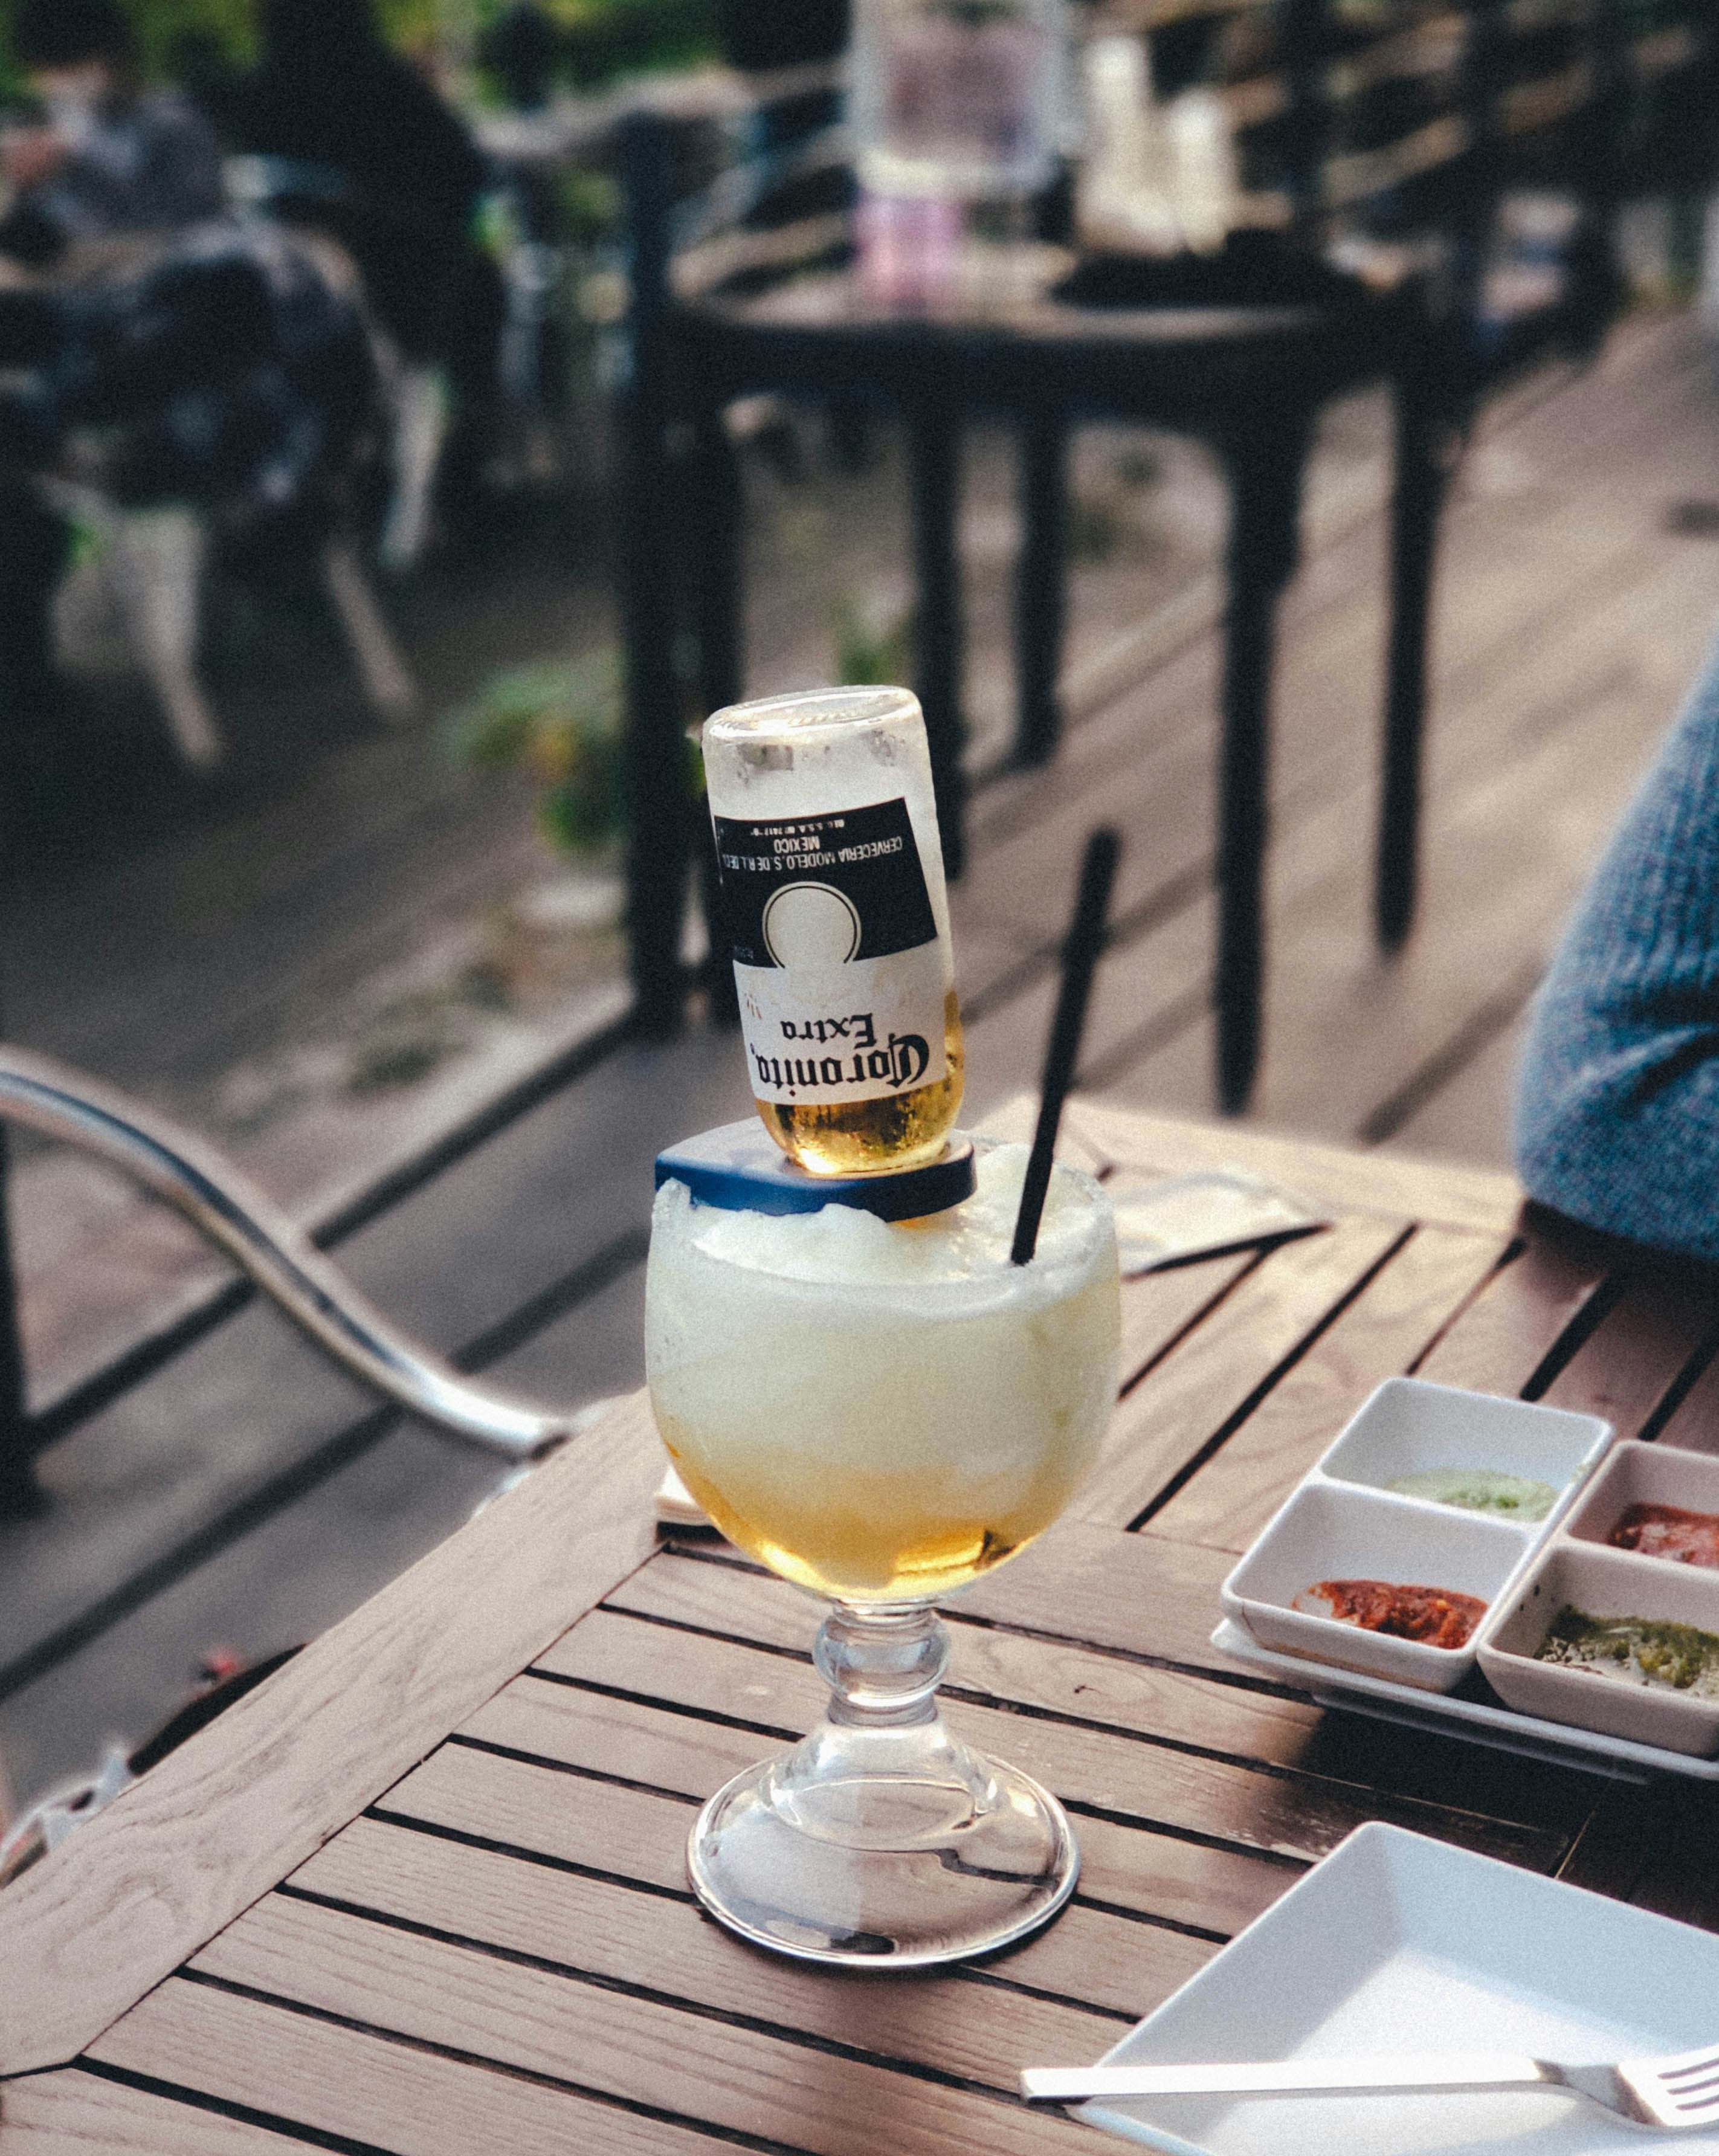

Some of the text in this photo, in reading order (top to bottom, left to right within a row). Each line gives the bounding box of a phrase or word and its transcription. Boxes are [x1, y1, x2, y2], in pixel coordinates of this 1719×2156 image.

[773, 835, 821, 854] MEXICO
[837, 836, 903, 863] CERVECERIA
[756, 856, 770, 871] DE
[779, 1012, 877, 1050] Extra
[755, 1033, 930, 1097] Coronita
